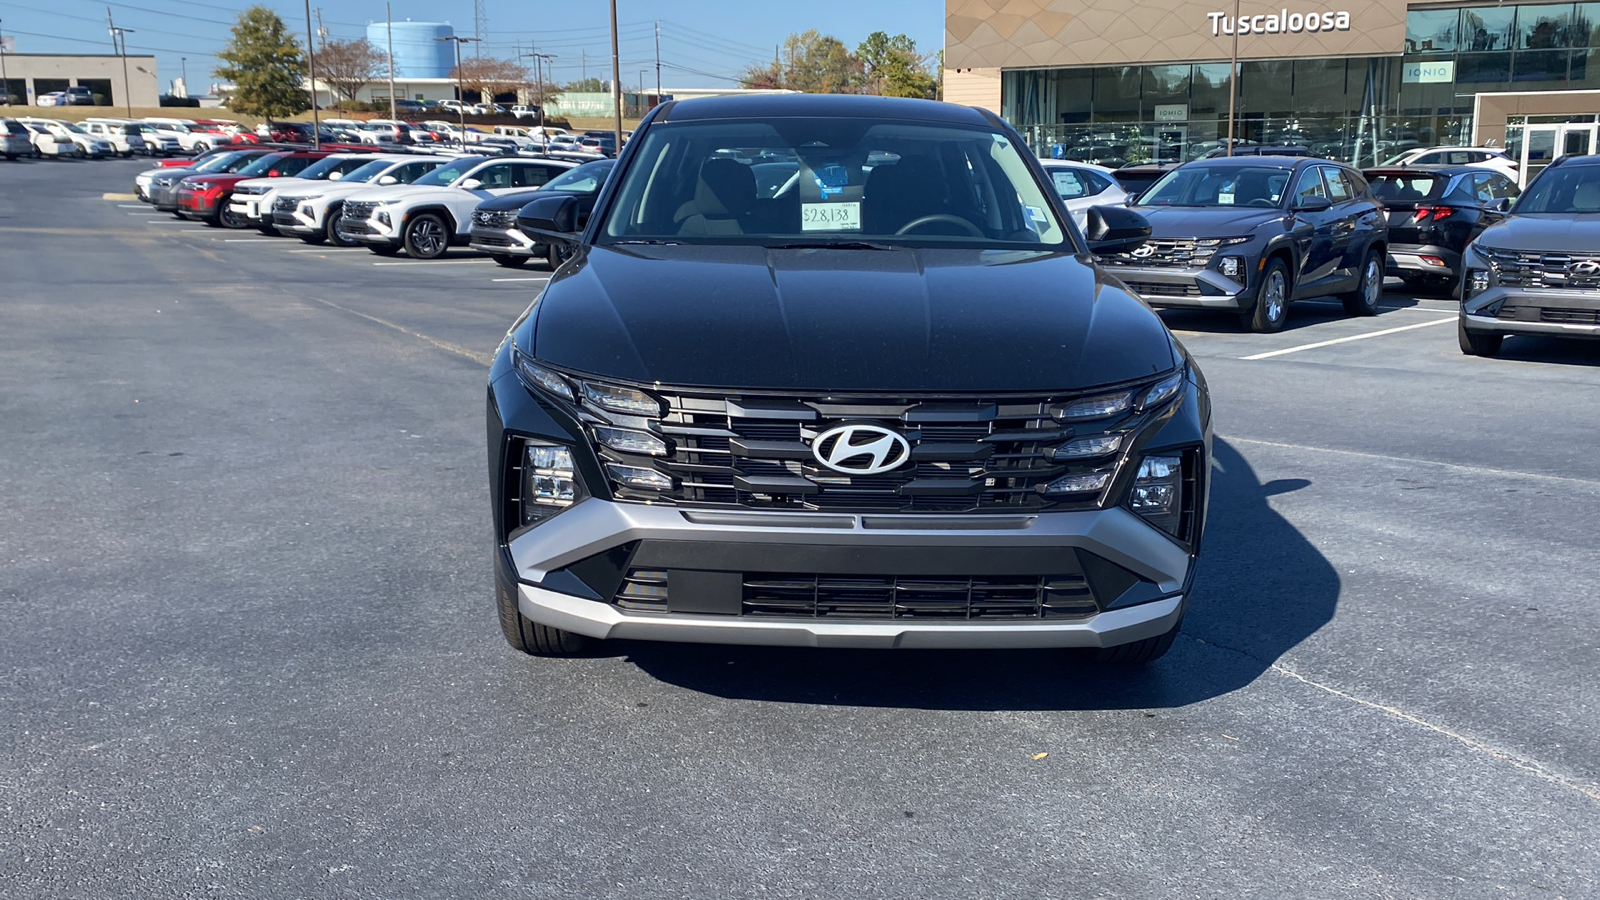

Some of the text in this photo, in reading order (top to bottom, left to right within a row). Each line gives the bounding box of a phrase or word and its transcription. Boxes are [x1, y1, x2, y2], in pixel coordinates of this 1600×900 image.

[1206, 8, 1350, 36] Tuscaloosa
[1408, 67, 1447, 77] IONIQ
[803, 208, 849, 223] $28,138
